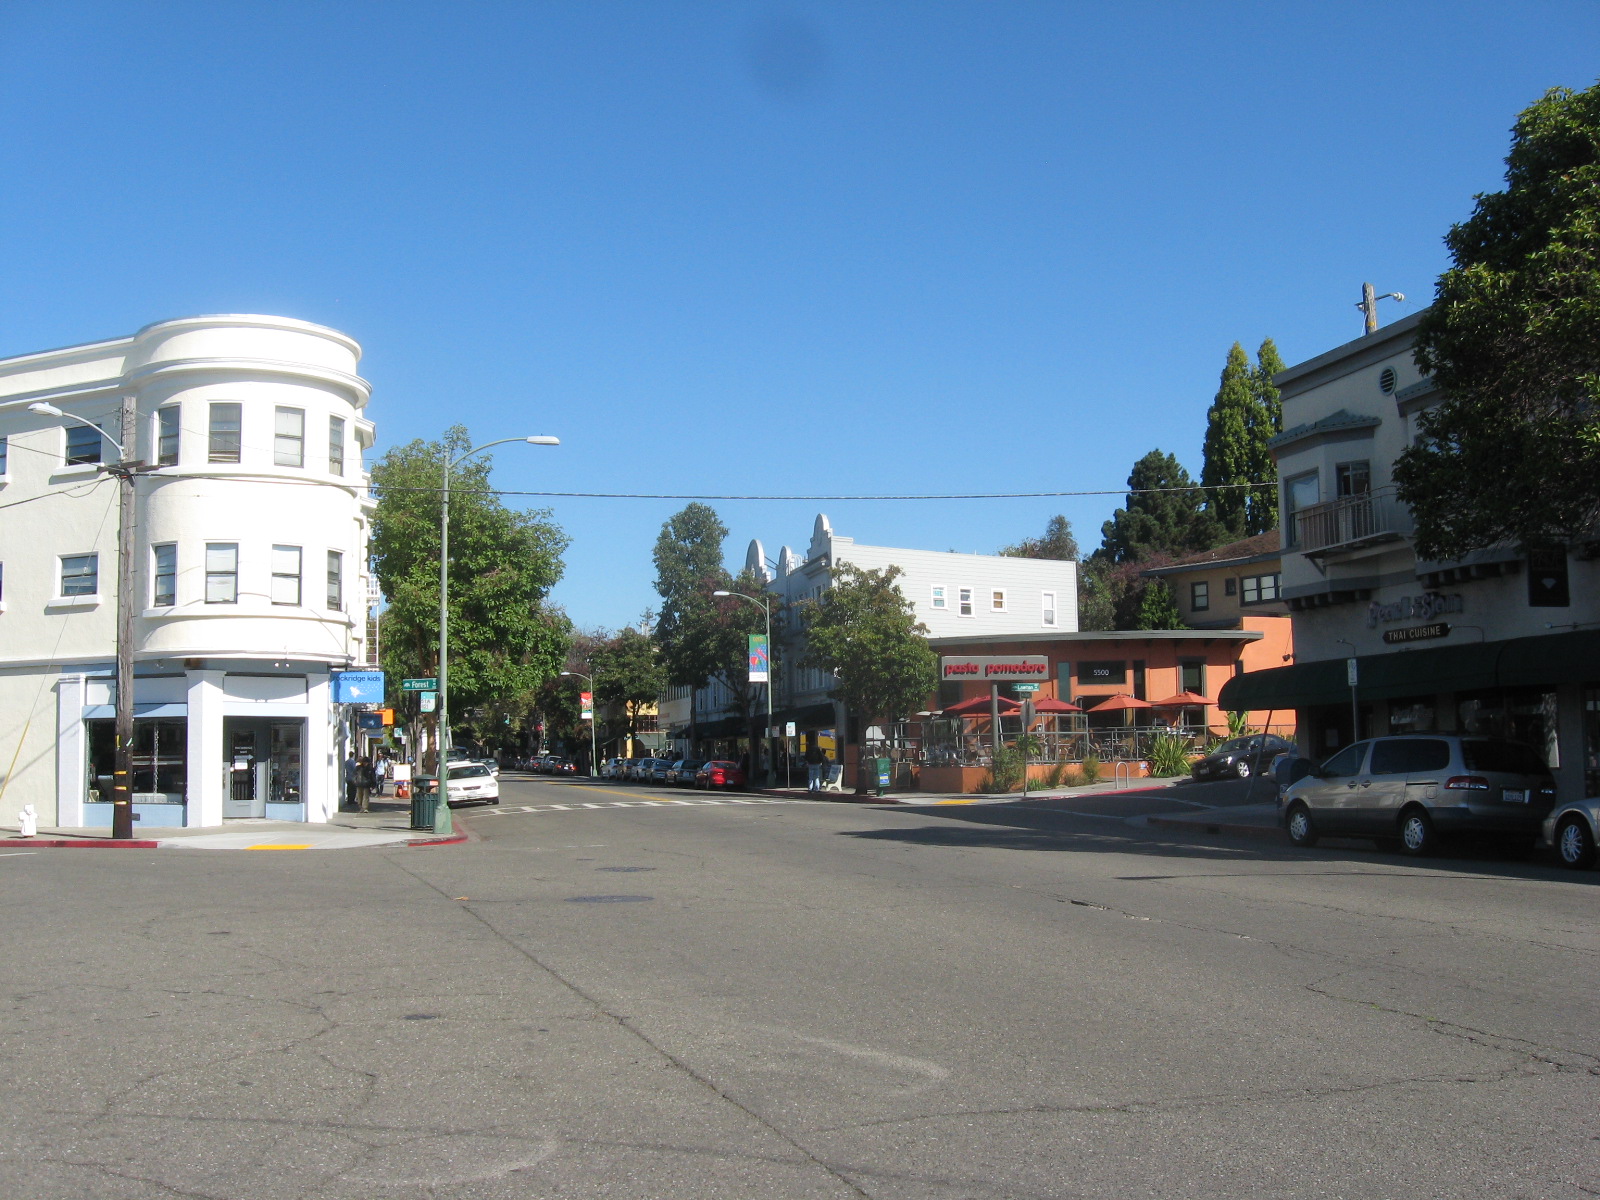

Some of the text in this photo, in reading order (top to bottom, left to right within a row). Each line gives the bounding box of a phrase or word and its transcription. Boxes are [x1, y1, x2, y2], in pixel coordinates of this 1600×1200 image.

[1388, 625, 1441, 641] THAI CUISINE
[945, 660, 1047, 676] pasta pomodoro
[411, 680, 429, 689] Forest
